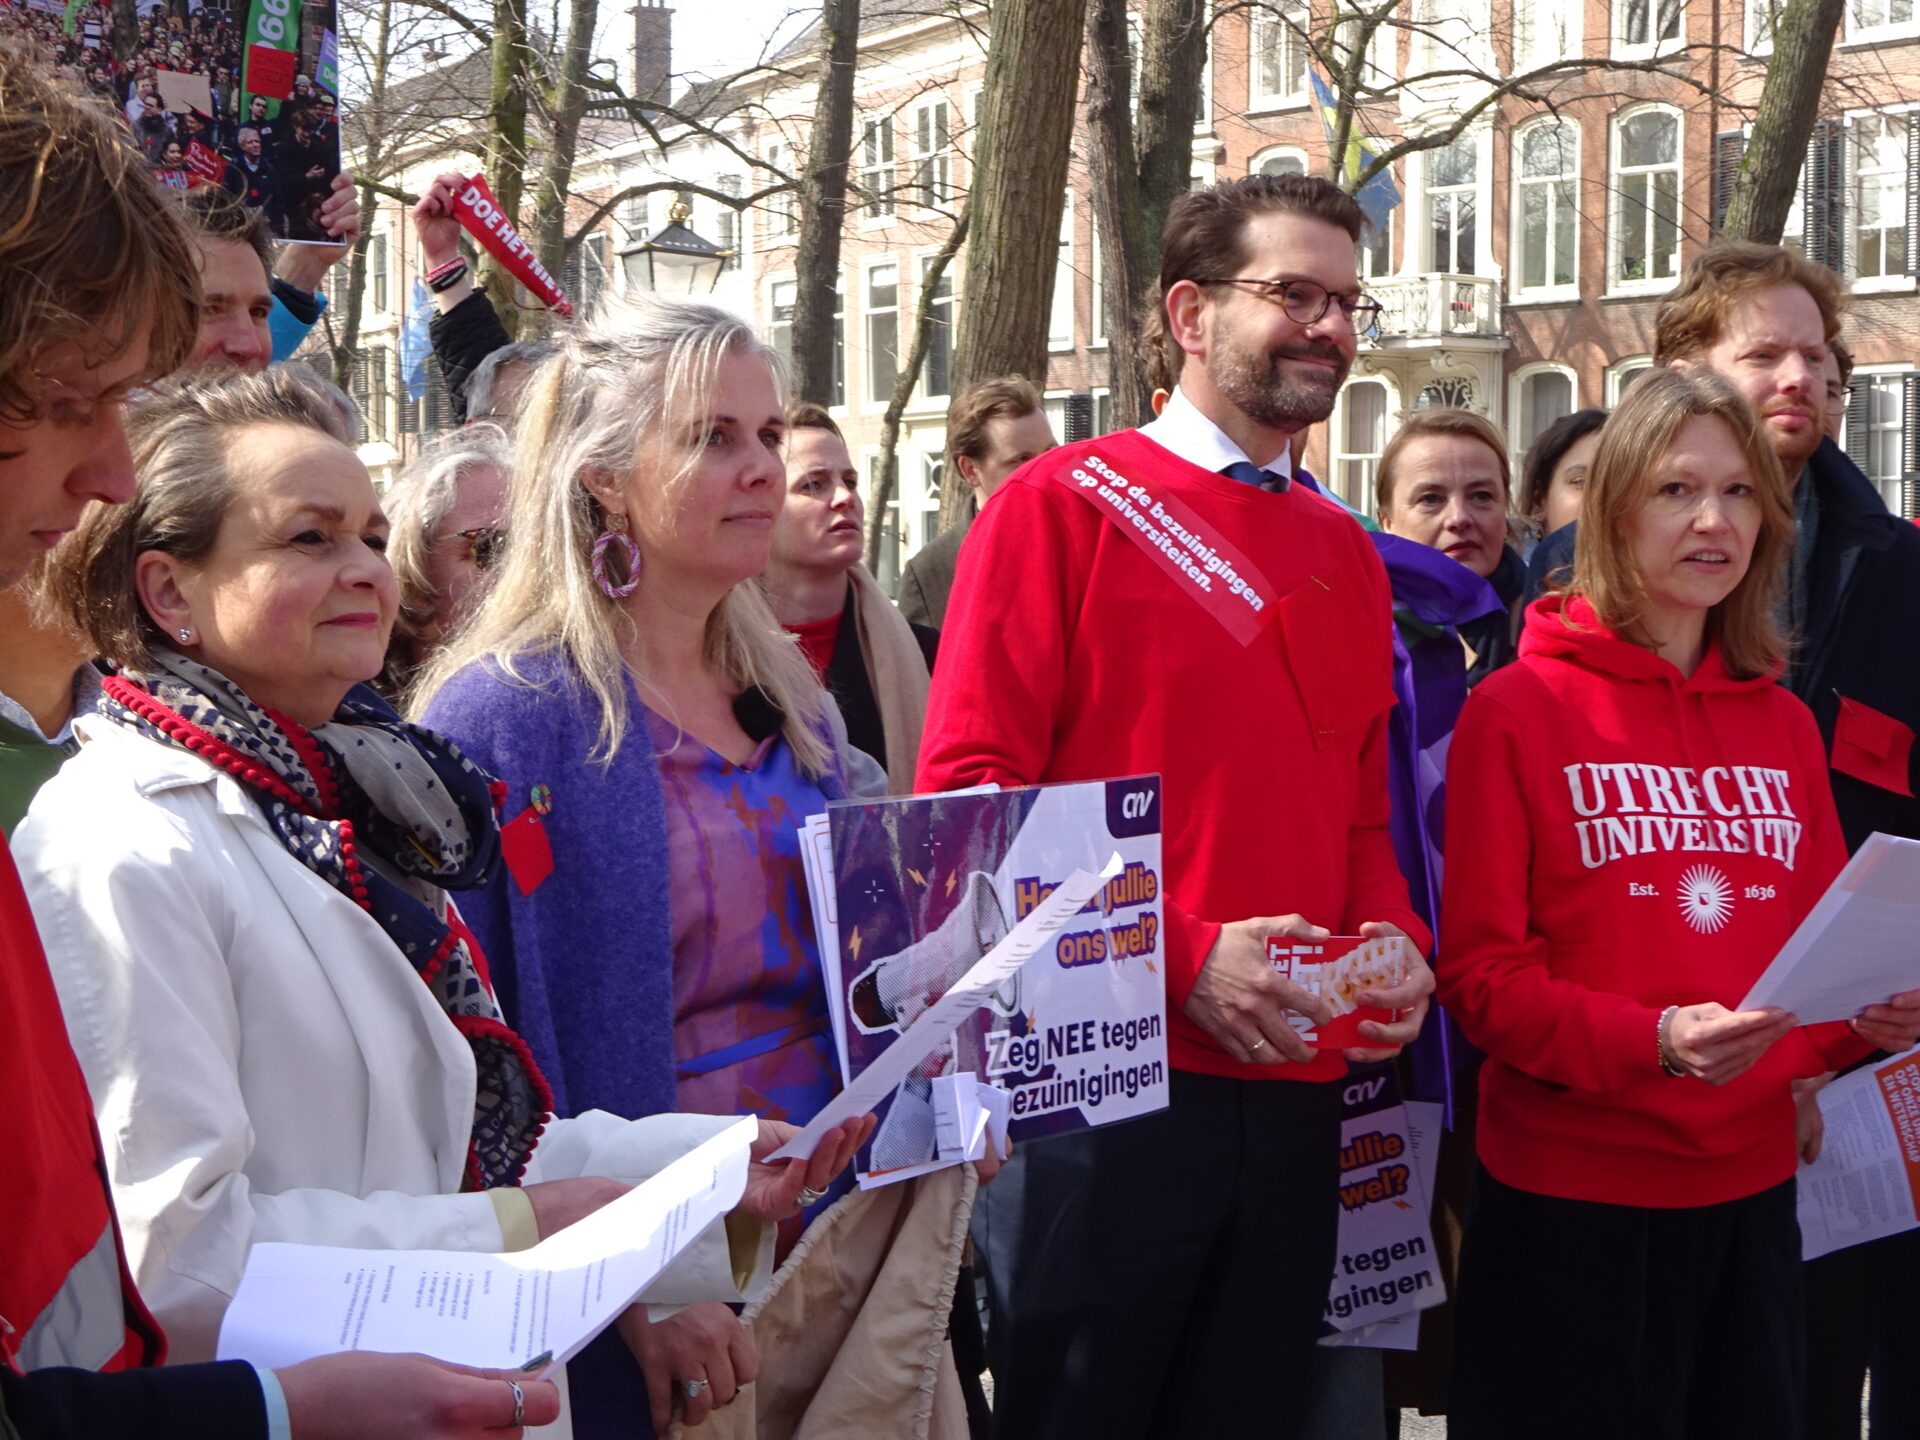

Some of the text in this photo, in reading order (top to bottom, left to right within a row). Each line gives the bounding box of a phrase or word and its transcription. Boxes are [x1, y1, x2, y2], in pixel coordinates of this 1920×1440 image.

[460, 186, 502, 229] DOE
[496, 223, 530, 259] HET
[1072, 469, 1212, 592] op universiteiten.
[1084, 456, 1265, 612] Stop de bezuinigingen
[1563, 763, 1797, 819] UTRECHT
[1574, 815, 1802, 871] UNIVERSITY
[1105, 866, 1157, 912] jullie
[1629, 882, 1659, 897] Est.
[1744, 885, 1776, 901] 1636
[1058, 934, 1105, 965] ons
[1109, 915, 1157, 957] wel?
[1269, 944, 1290, 977] ET
[988, 1014, 1161, 1071] Zeg NEE tegen
[1009, 1060, 1163, 1116] ezuinigingen
[1883, 1074, 1897, 1091] EN
[1339, 1134, 1404, 1169] ullie
[1340, 1166, 1409, 1207] wel?
[1341, 1236, 1427, 1275] tegen
